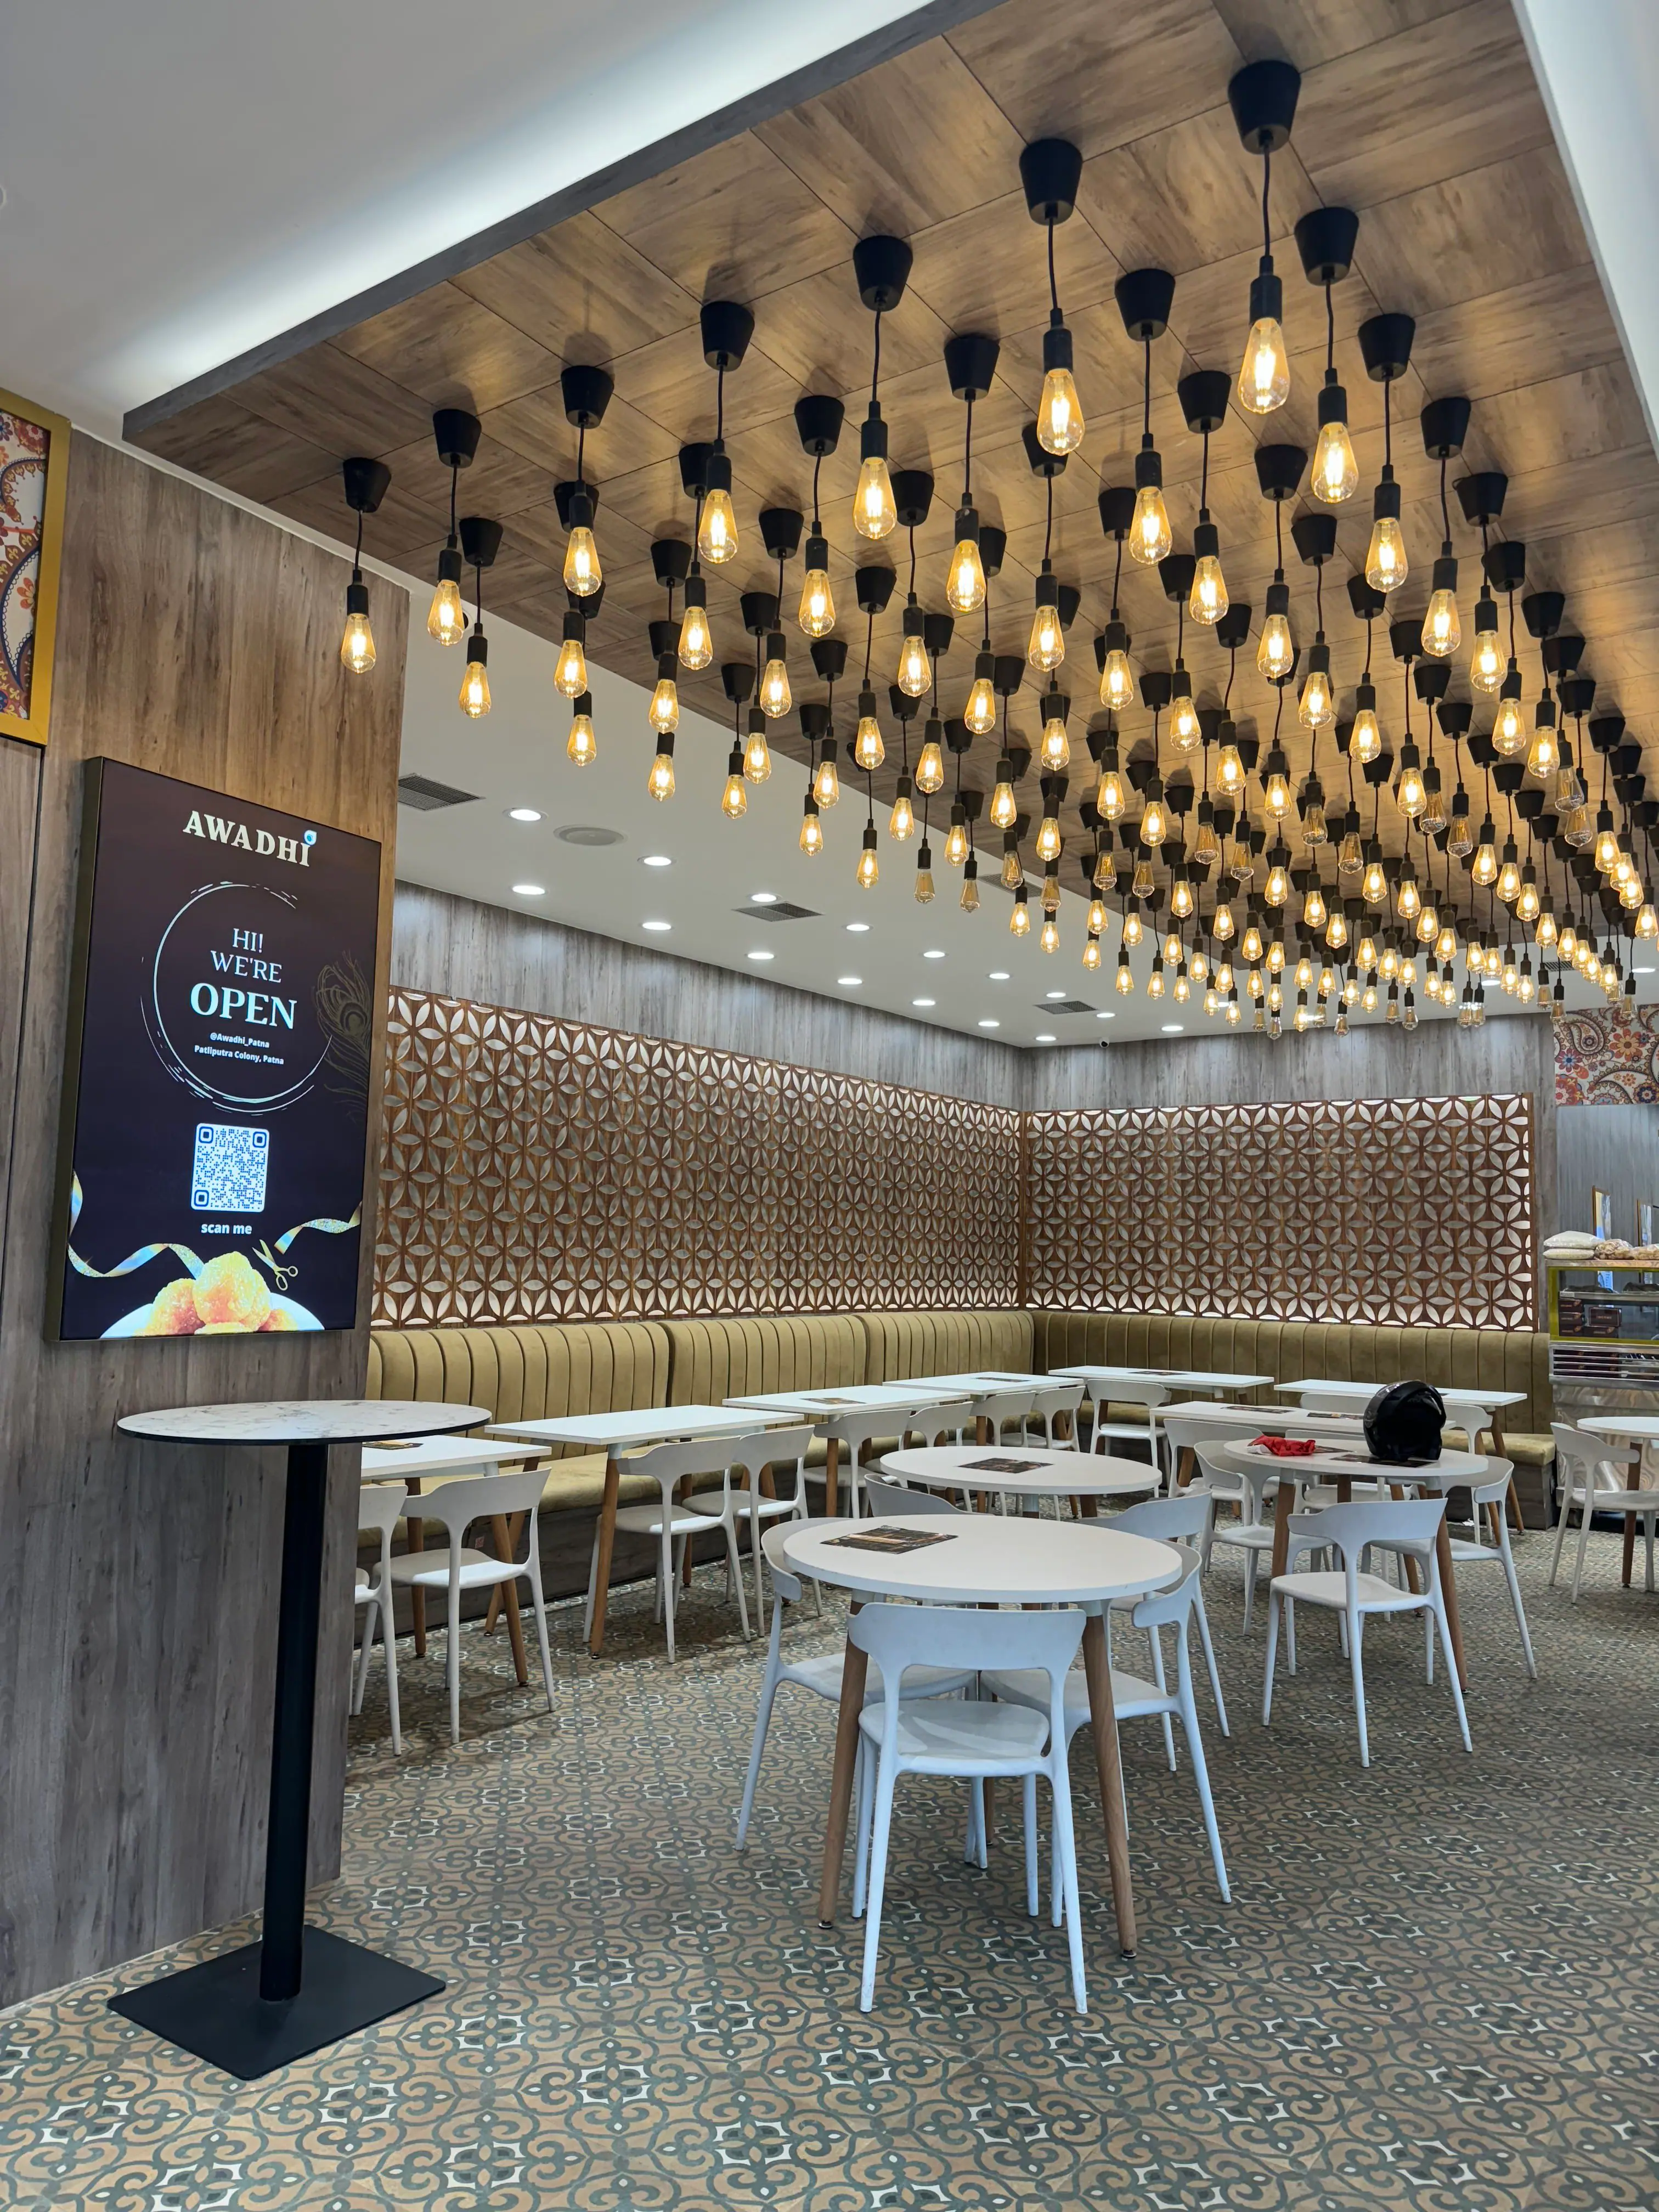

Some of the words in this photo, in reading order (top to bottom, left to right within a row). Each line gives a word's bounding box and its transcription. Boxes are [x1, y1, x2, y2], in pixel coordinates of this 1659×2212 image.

[183, 810, 311, 867] AWADHI
[232, 928, 263, 953] HI!
[210, 950, 282, 983] WE'RE
[190, 983, 297, 1029] OPEN
[210, 1032, 270, 1048] @Awadhi_Patna
[194, 1045, 233, 1057] Patliputra
[234, 1051, 261, 1063] Colony,
[263, 1055, 284, 1065] Patna
[201, 1223, 230, 1234] scan
[233, 1224, 252, 1234] me
